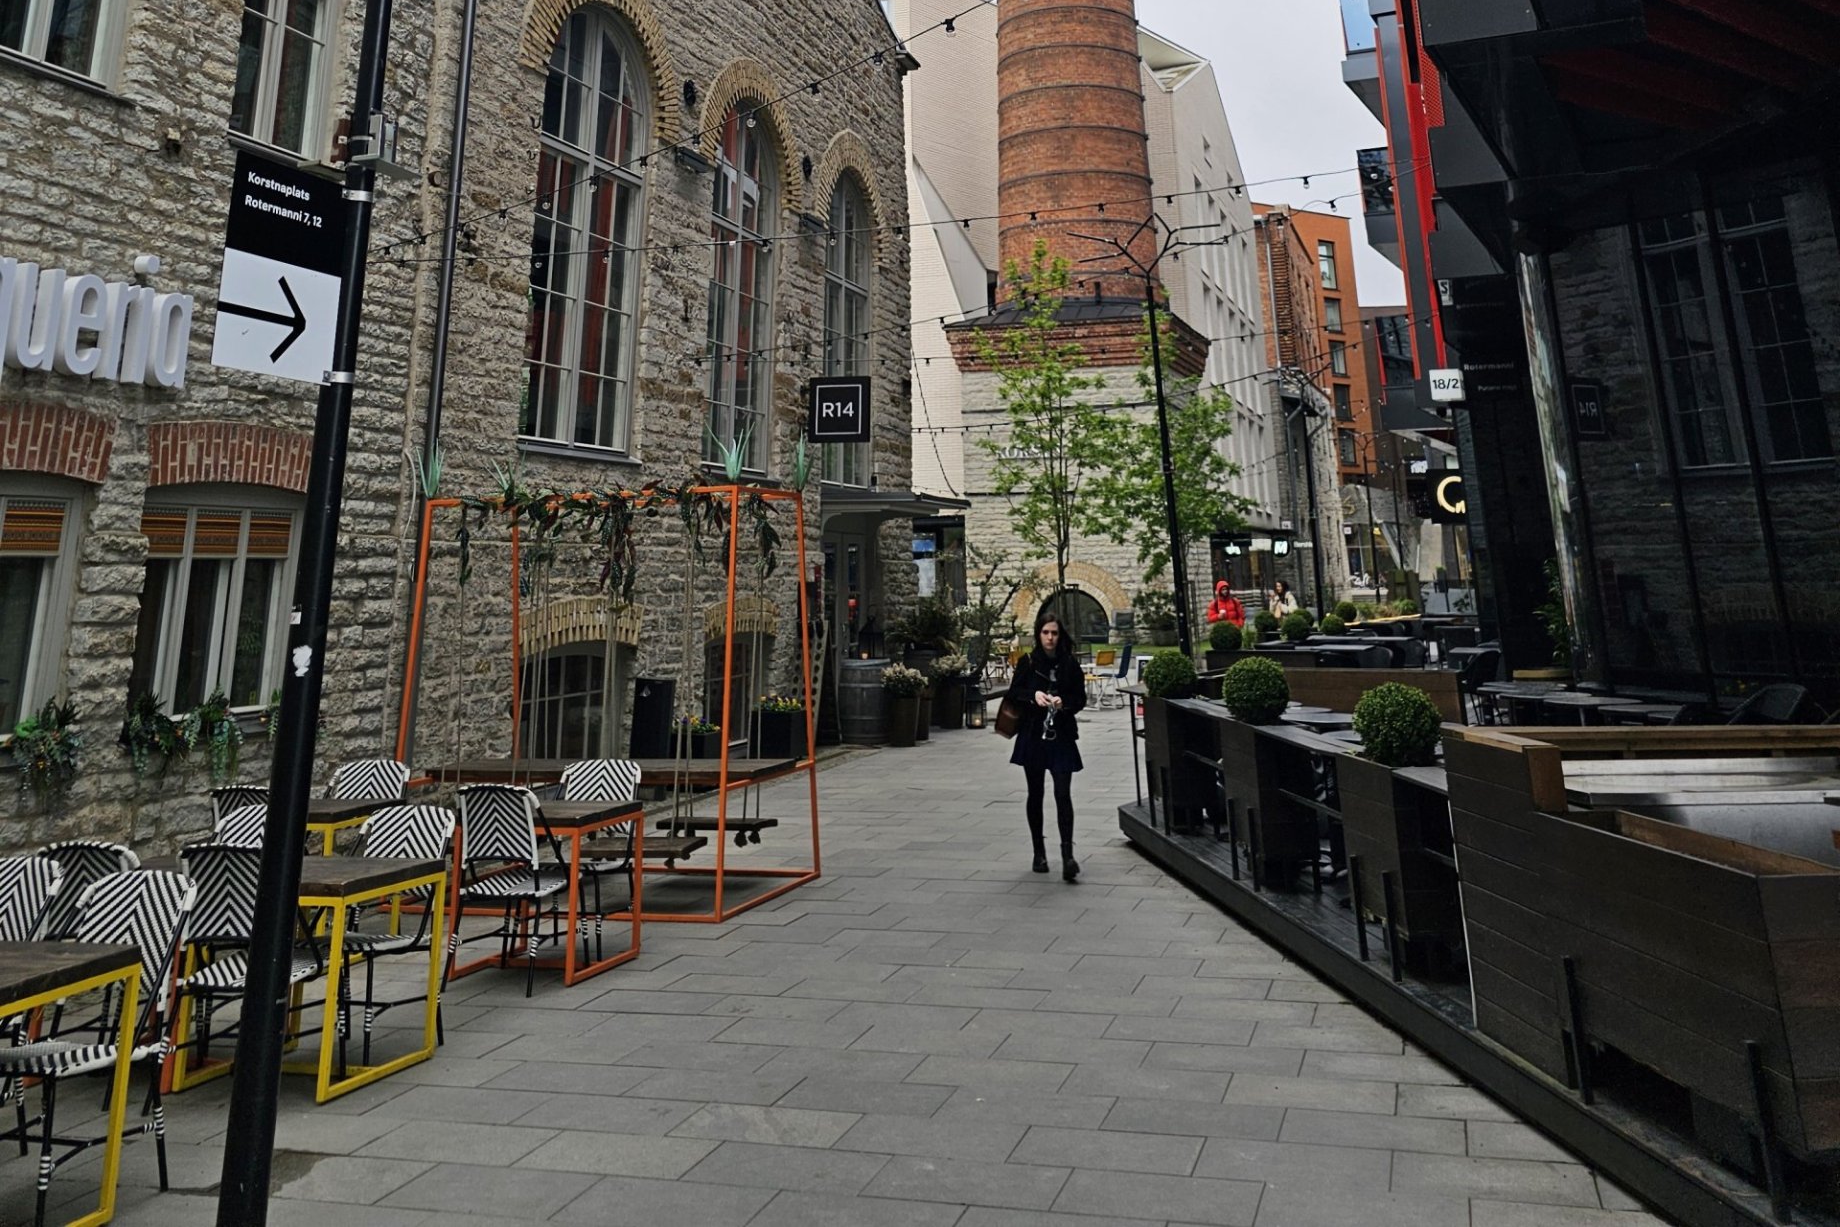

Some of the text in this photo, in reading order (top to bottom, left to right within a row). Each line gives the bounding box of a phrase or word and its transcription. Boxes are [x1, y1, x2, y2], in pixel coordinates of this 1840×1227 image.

[248, 171, 310, 201] Korstnaplats
[245, 194, 323, 228] Rotermanni 7, 12
[1433, 379, 1459, 390] 18/2
[822, 401, 855, 418] R14
